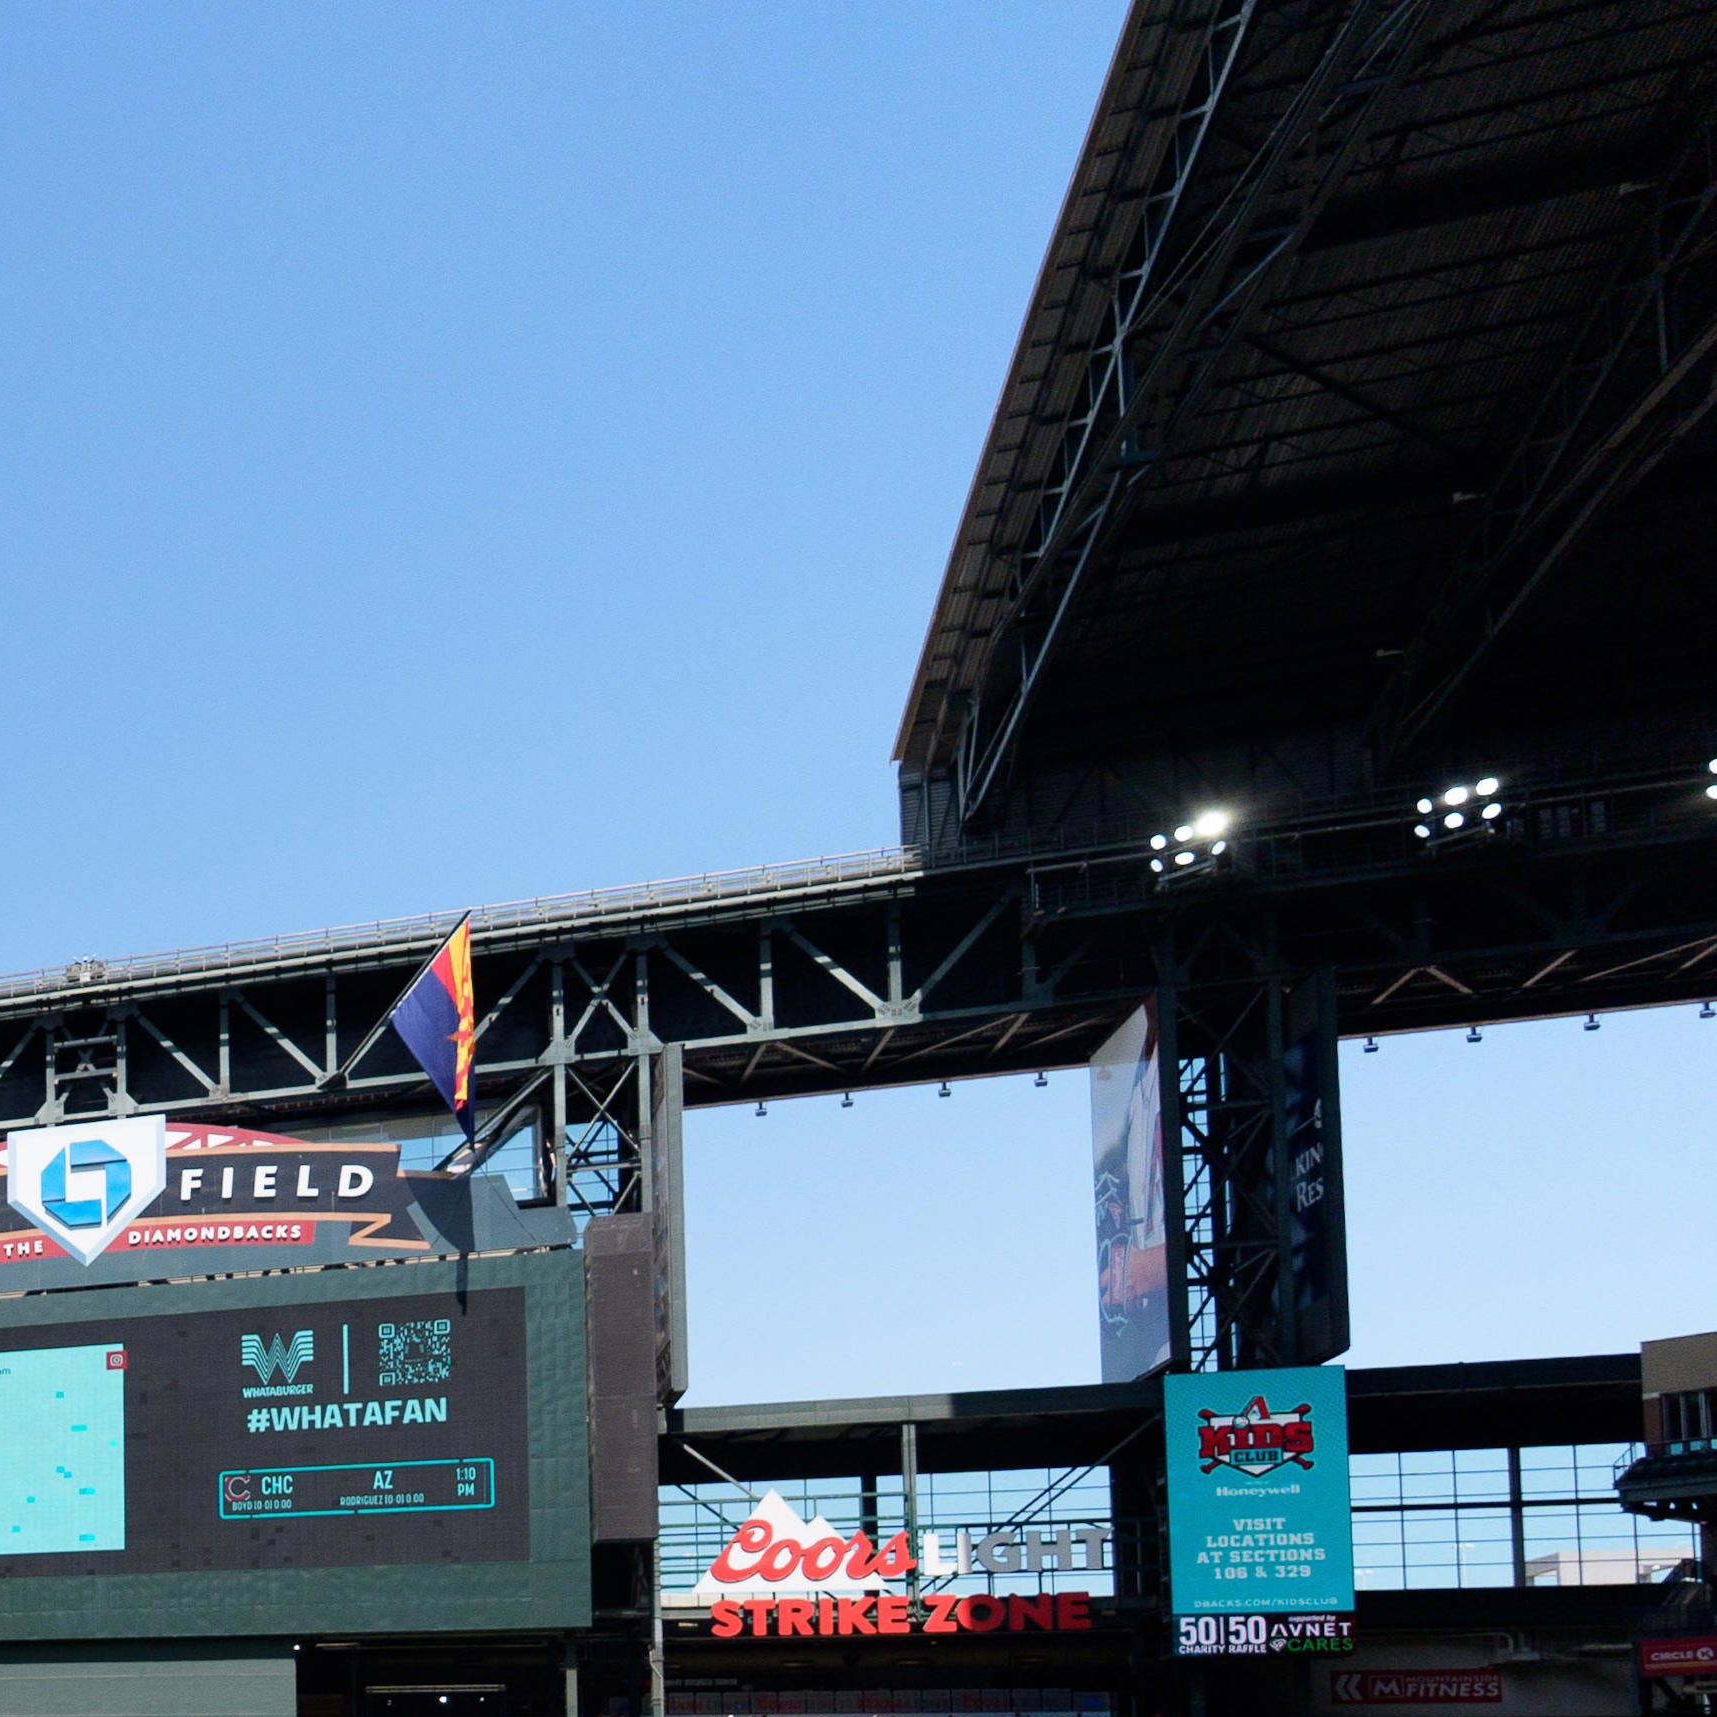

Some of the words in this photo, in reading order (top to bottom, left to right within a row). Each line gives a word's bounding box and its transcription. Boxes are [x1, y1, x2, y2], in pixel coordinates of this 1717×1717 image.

[181, 1163, 375, 1201] FIELD
[4, 1239, 43, 1256] THE
[128, 1224, 302, 1245] DIAMONDBACKS
[243, 1384, 313, 1398] WHATABURGER
[247, 1397, 447, 1433] #WHATAFAN
[1199, 1422, 1314, 1458] KIDS
[1234, 1451, 1278, 1463] CLUB
[456, 1467, 475, 1481] 1:10
[261, 1476, 293, 1495] CHC
[373, 1471, 393, 1489] AZ
[458, 1483, 475, 1497] PM
[1216, 1485, 1300, 1497] Honeywell
[340, 1496, 383, 1505] RODRIGUEZ
[1234, 1518, 1286, 1530] VISIT
[1206, 1533, 1314, 1548] LOCATIONS
[711, 1519, 918, 1583] Coors
[923, 1527, 1112, 1576] LIGHT
[1197, 1551, 1220, 1563] AT
[1230, 1548, 1326, 1563] SECTIONS
[1255, 1567, 1268, 1578] &
[1275, 1565, 1311, 1578] 329
[1194, 1597, 1338, 1608] DBACKS.COM/KIDSCLUB
[711, 1596, 911, 1637] STRIKE
[922, 1591, 1091, 1632] ZONE
[1271, 1623, 1351, 1637] AVNET
[1179, 1645, 1225, 1654] CHARITY
[1229, 1645, 1267, 1653] RAFFLE
[1288, 1638, 1353, 1651] CARES
[1650, 1651, 1694, 1661] CIRCLE
[1407, 1675, 1499, 1683] MOUNTAINSIDE
[1406, 1683, 1499, 1697] FITNESS
